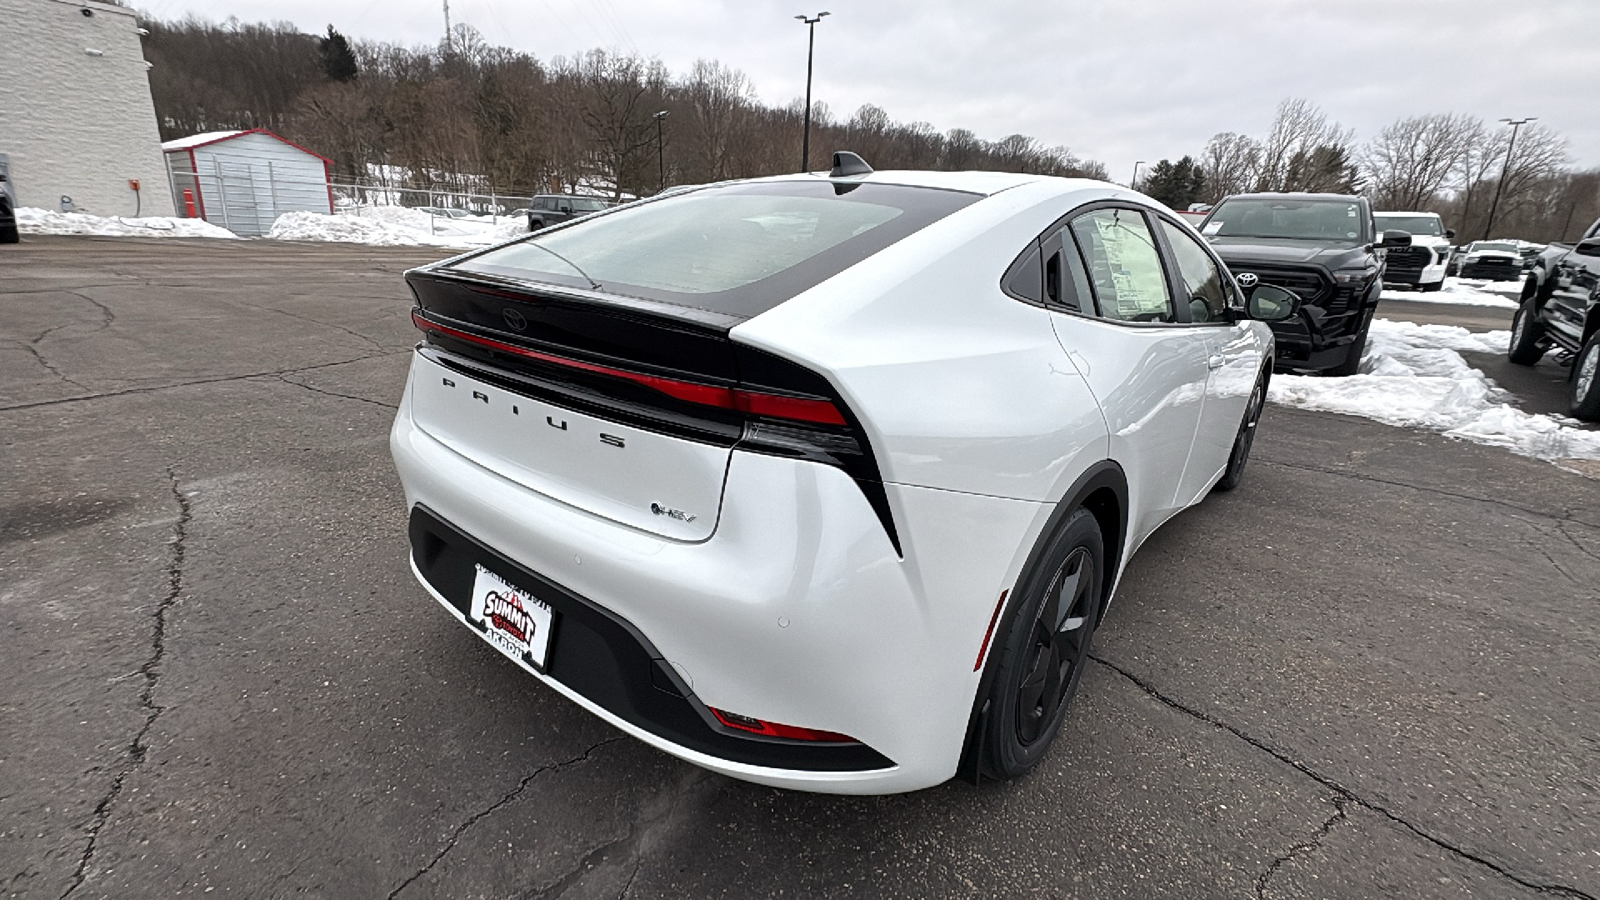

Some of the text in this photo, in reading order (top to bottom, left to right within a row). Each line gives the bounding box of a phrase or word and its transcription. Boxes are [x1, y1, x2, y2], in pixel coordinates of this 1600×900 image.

[443, 378, 625, 448] PRIUS
[484, 593, 535, 645] SUMMIT
[502, 621, 524, 640] TOYOTA
[486, 629, 523, 658] AKRON
